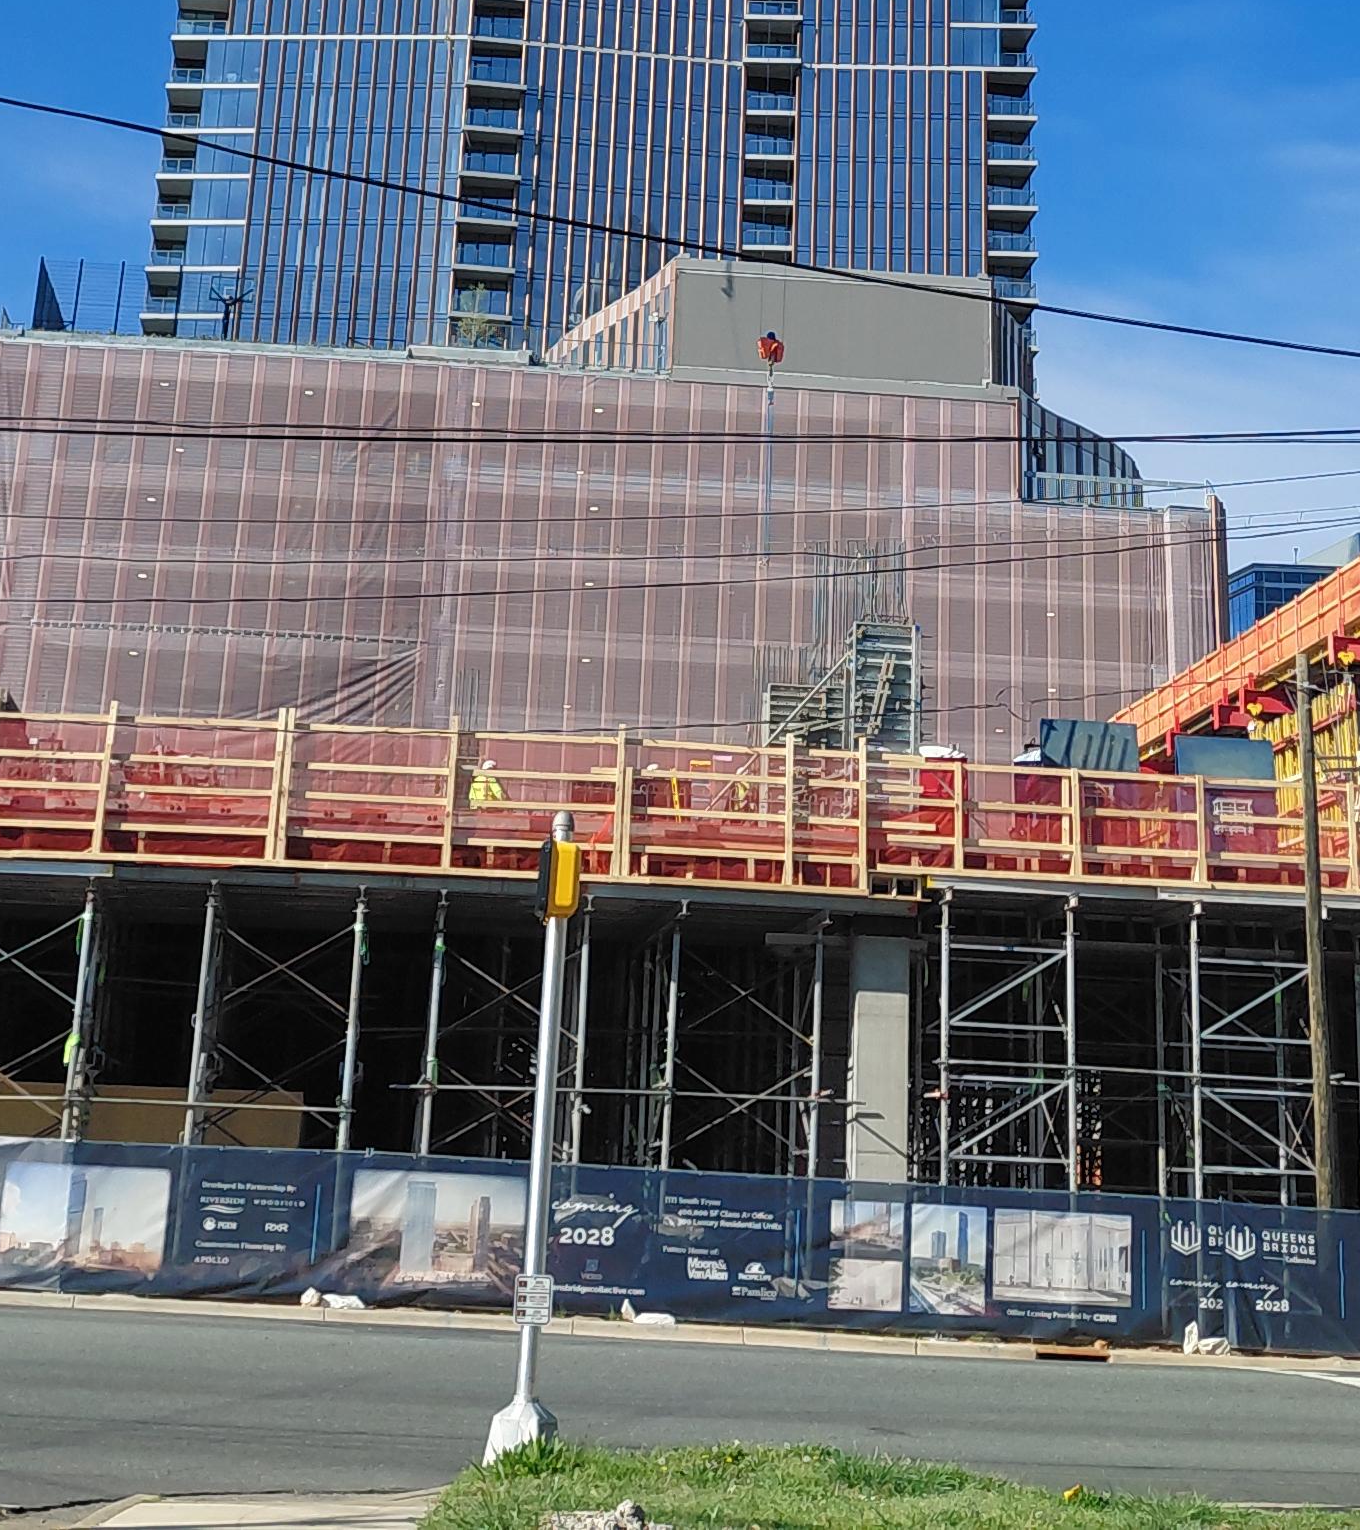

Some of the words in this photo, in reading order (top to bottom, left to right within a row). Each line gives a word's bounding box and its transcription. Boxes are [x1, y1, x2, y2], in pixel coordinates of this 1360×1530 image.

[200, 1196, 246, 1205] RIVERSIDE
[551, 1193, 639, 1229] coming
[265, 1222, 289, 1232] RXR
[559, 1227, 614, 1246] 2028
[1261, 1230, 1316, 1244] QUEENS
[1263, 1242, 1316, 1256] BRIDGE
[194, 1255, 230, 1264] APOLLO
[742, 1286, 777, 1298] Pamlico
[1170, 1274, 1221, 1298] coming
[1226, 1276, 1279, 1300] coming
[1199, 1298, 1224, 1310] 202
[1256, 1299, 1290, 1312] 2028
